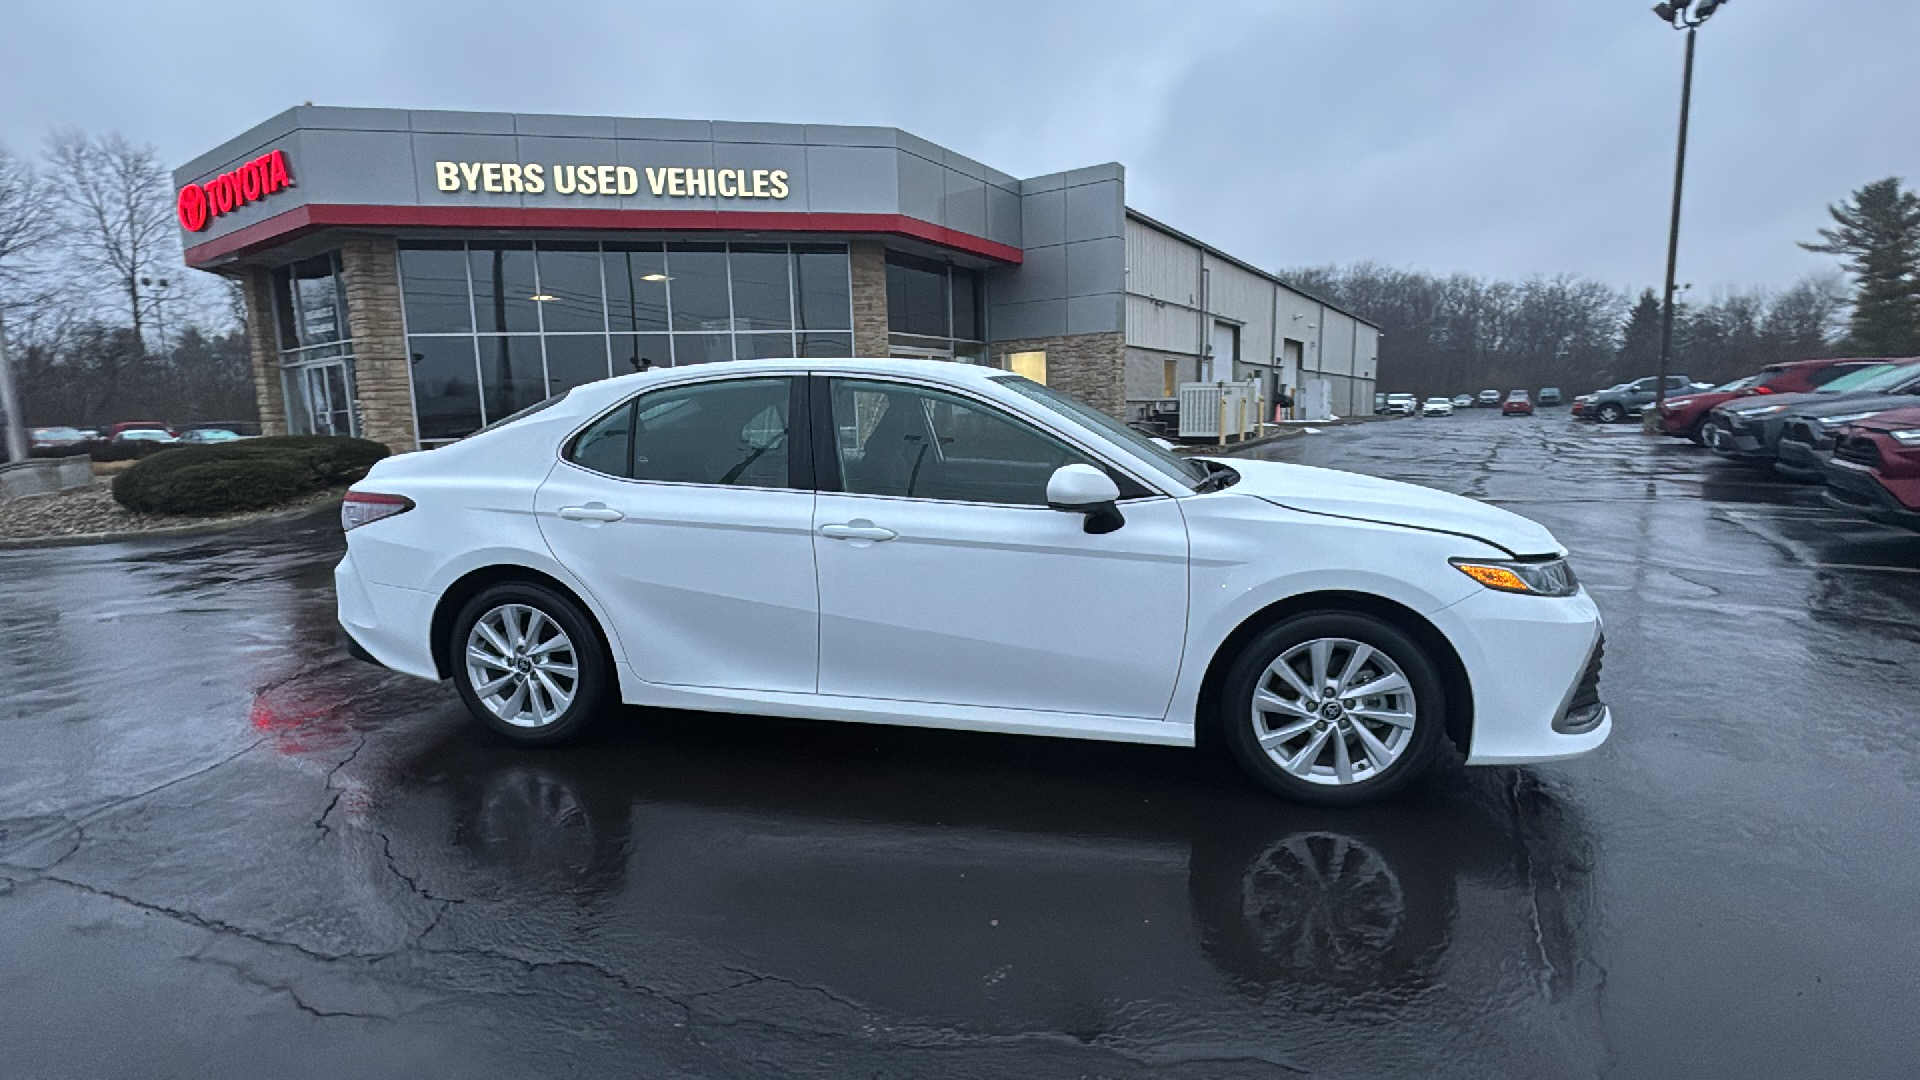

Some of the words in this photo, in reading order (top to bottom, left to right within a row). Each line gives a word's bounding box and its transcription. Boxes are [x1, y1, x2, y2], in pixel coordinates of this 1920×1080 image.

[204, 149, 290, 217] TOYOTA
[436, 161, 545, 193] BYERS
[553, 165, 639, 195] USED
[645, 167, 789, 199] VEHICLES
